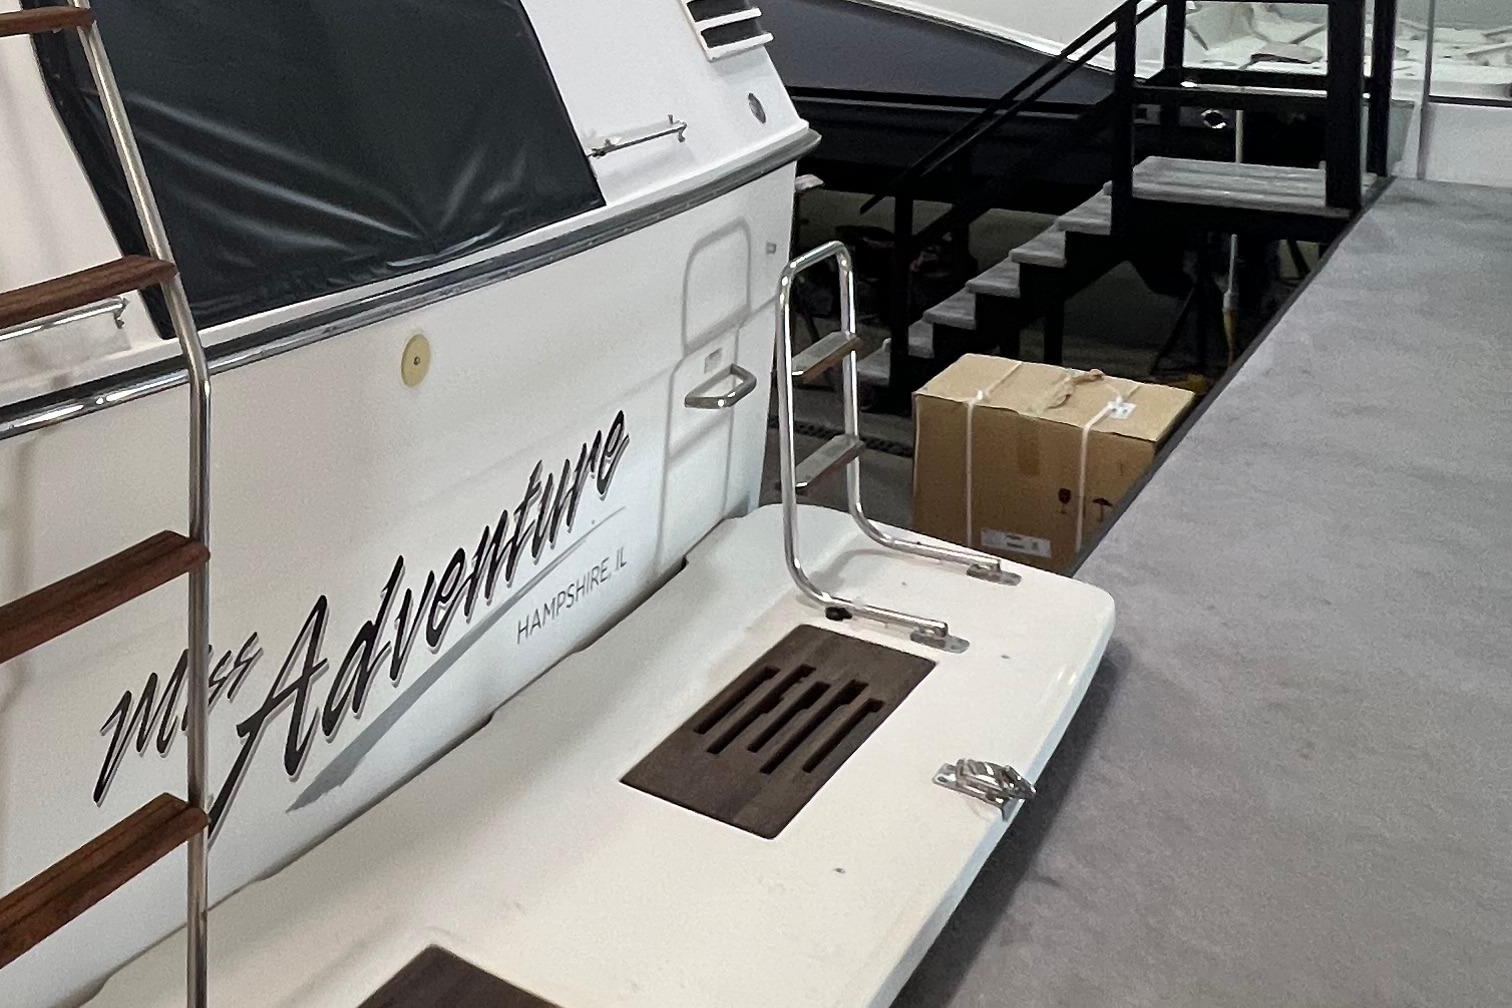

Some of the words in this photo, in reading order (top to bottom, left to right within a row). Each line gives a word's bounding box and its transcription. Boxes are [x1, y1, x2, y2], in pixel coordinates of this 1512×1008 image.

[93, 631, 262, 805] Mss
[207, 410, 629, 842] Adventure
[615, 546, 627, 571] IL
